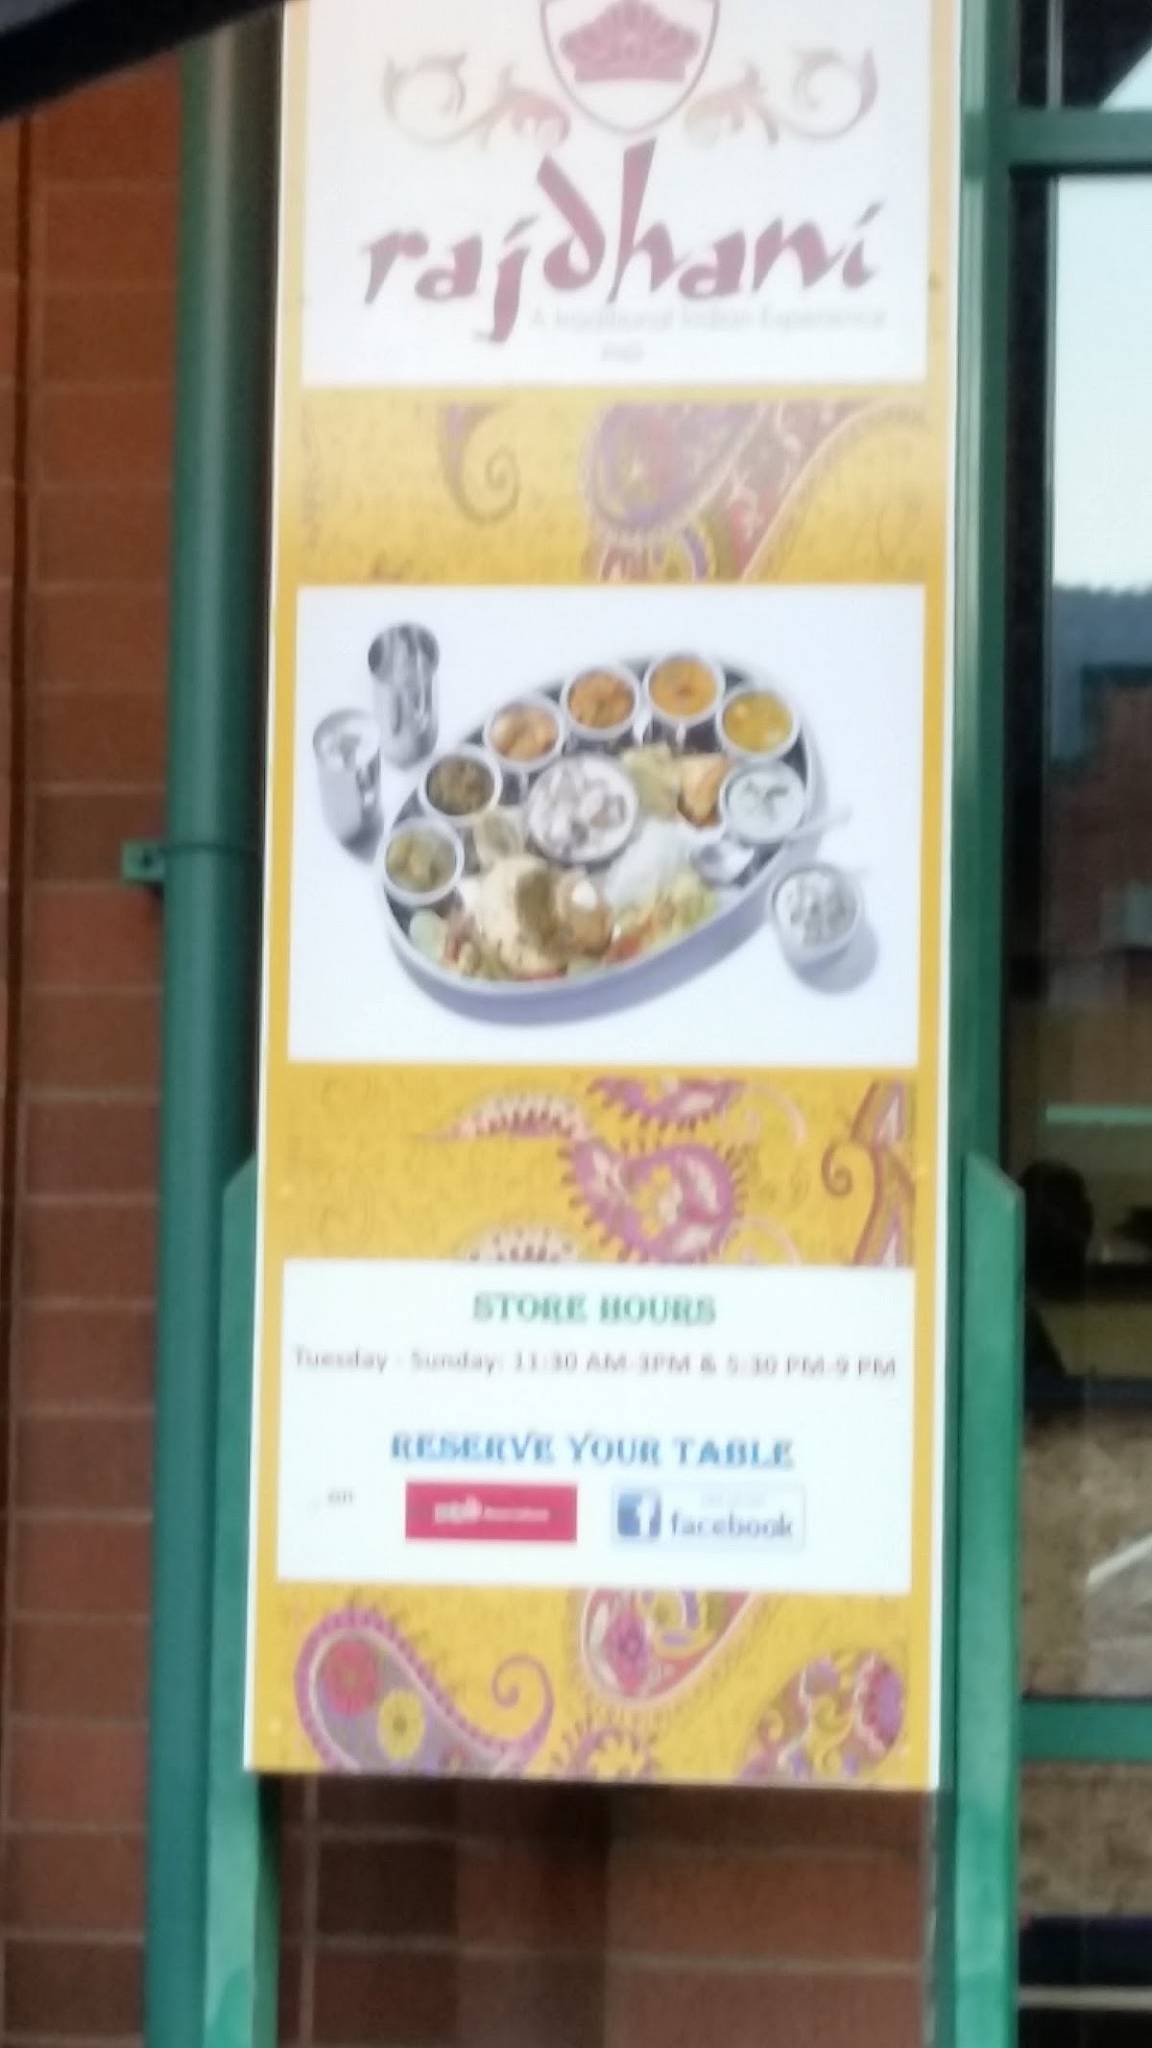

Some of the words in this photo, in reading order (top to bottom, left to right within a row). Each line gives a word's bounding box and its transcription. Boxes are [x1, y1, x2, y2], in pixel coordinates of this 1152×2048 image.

[360, 136, 887, 344] rajdhani
[472, 1291, 587, 1322] STORE
[600, 1294, 716, 1325] HOURS
[295, 1345, 388, 1374] Tuesday
[514, 1350, 579, 1374] 11:30
[391, 1432, 553, 1463] RESERVE
[569, 1431, 661, 1466] YOUR
[672, 1436, 795, 1468] TABLE
[671, 1508, 791, 1537] facebook
